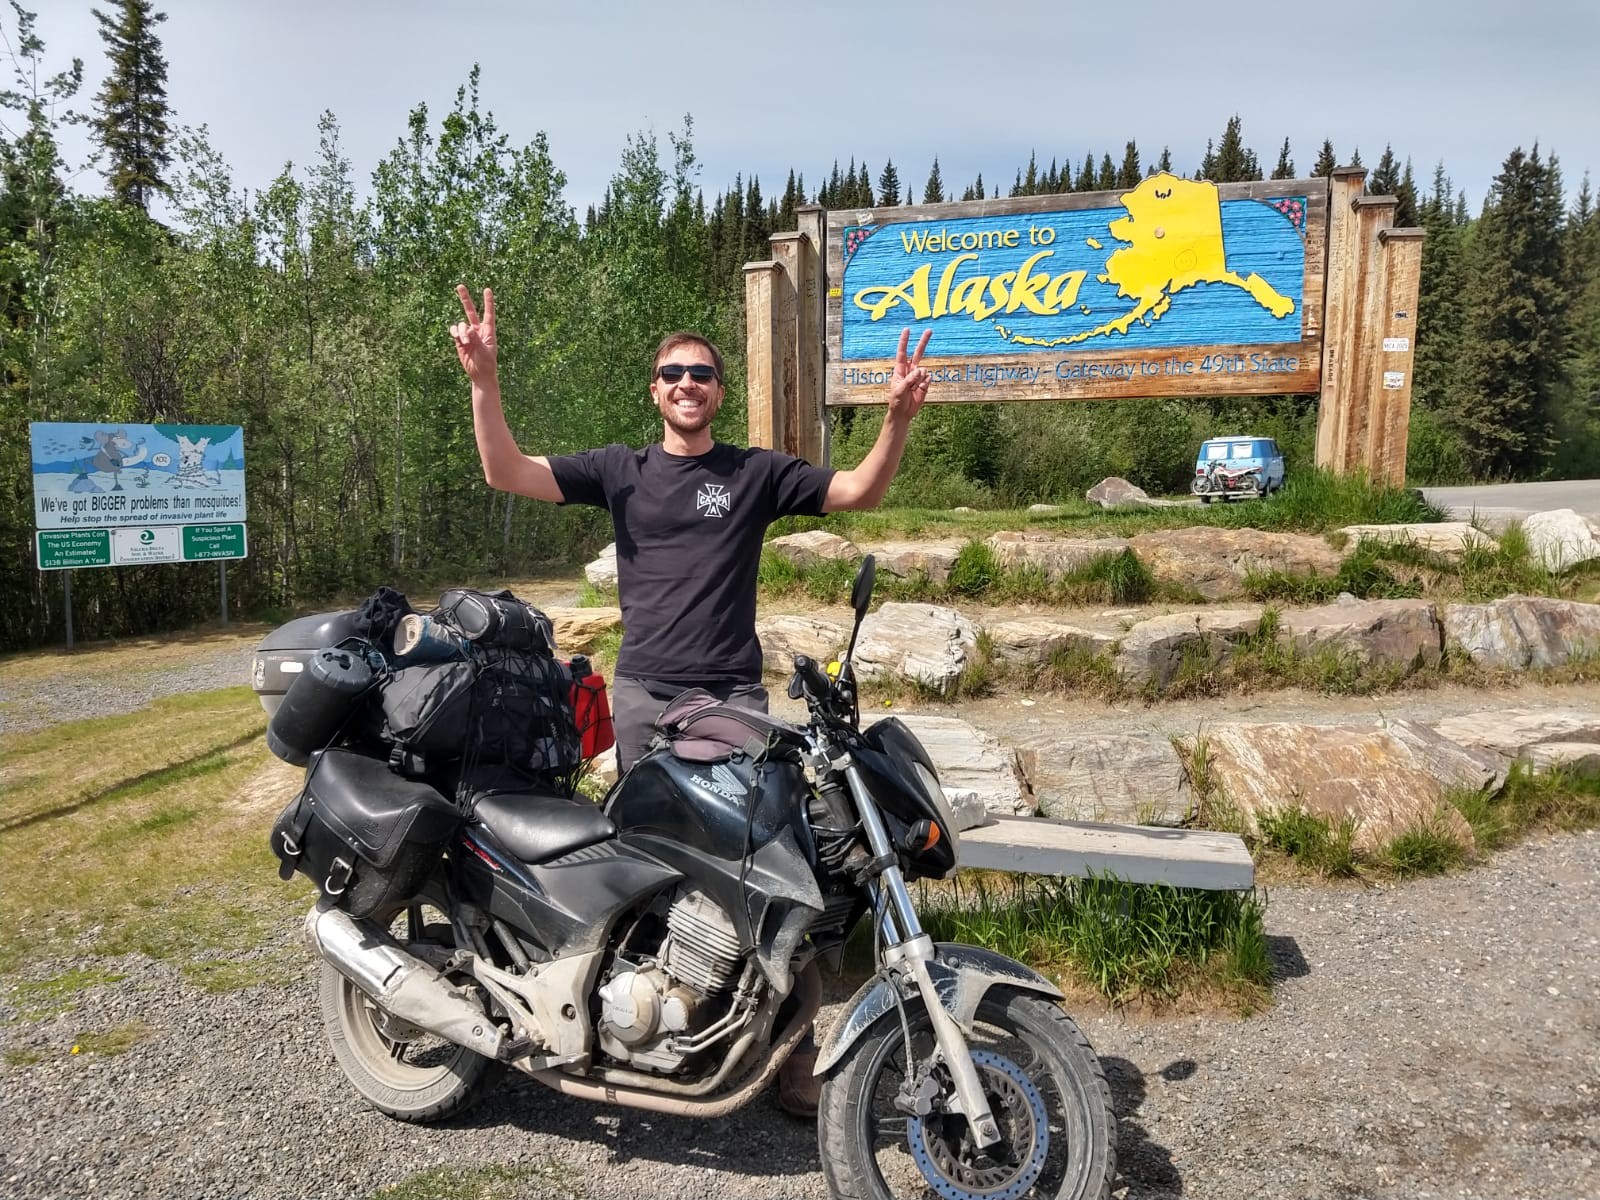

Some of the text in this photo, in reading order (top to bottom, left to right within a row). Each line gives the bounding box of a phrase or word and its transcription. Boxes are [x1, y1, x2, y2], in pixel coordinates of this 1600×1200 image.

[901, 224, 1056, 254] Welcome to
[853, 250, 1088, 322] Alaska
[843, 367, 896, 385] Histori
[965, 363, 1040, 387] Highway
[1056, 359, 1135, 381] Gateway
[1140, 358, 1160, 377] to
[1164, 355, 1194, 376] the
[1200, 353, 1245, 374] 49th
[1250, 352, 1298, 372] State
[41, 493, 242, 515] We've got BIGGER problems than mosquitoes!
[60, 515, 81, 524] Help
[82, 514, 102, 524] stop
[104, 514, 118, 522] the
[119, 513, 148, 522] spread
[160, 511, 193, 520] invasive
[193, 511, 214, 521] plant
[215, 510, 227, 519] life
[213, 525, 227, 533] Spot
[71, 540, 102, 548] Economy
[208, 542, 220, 550] Call
[690, 774, 740, 808] HONDA
